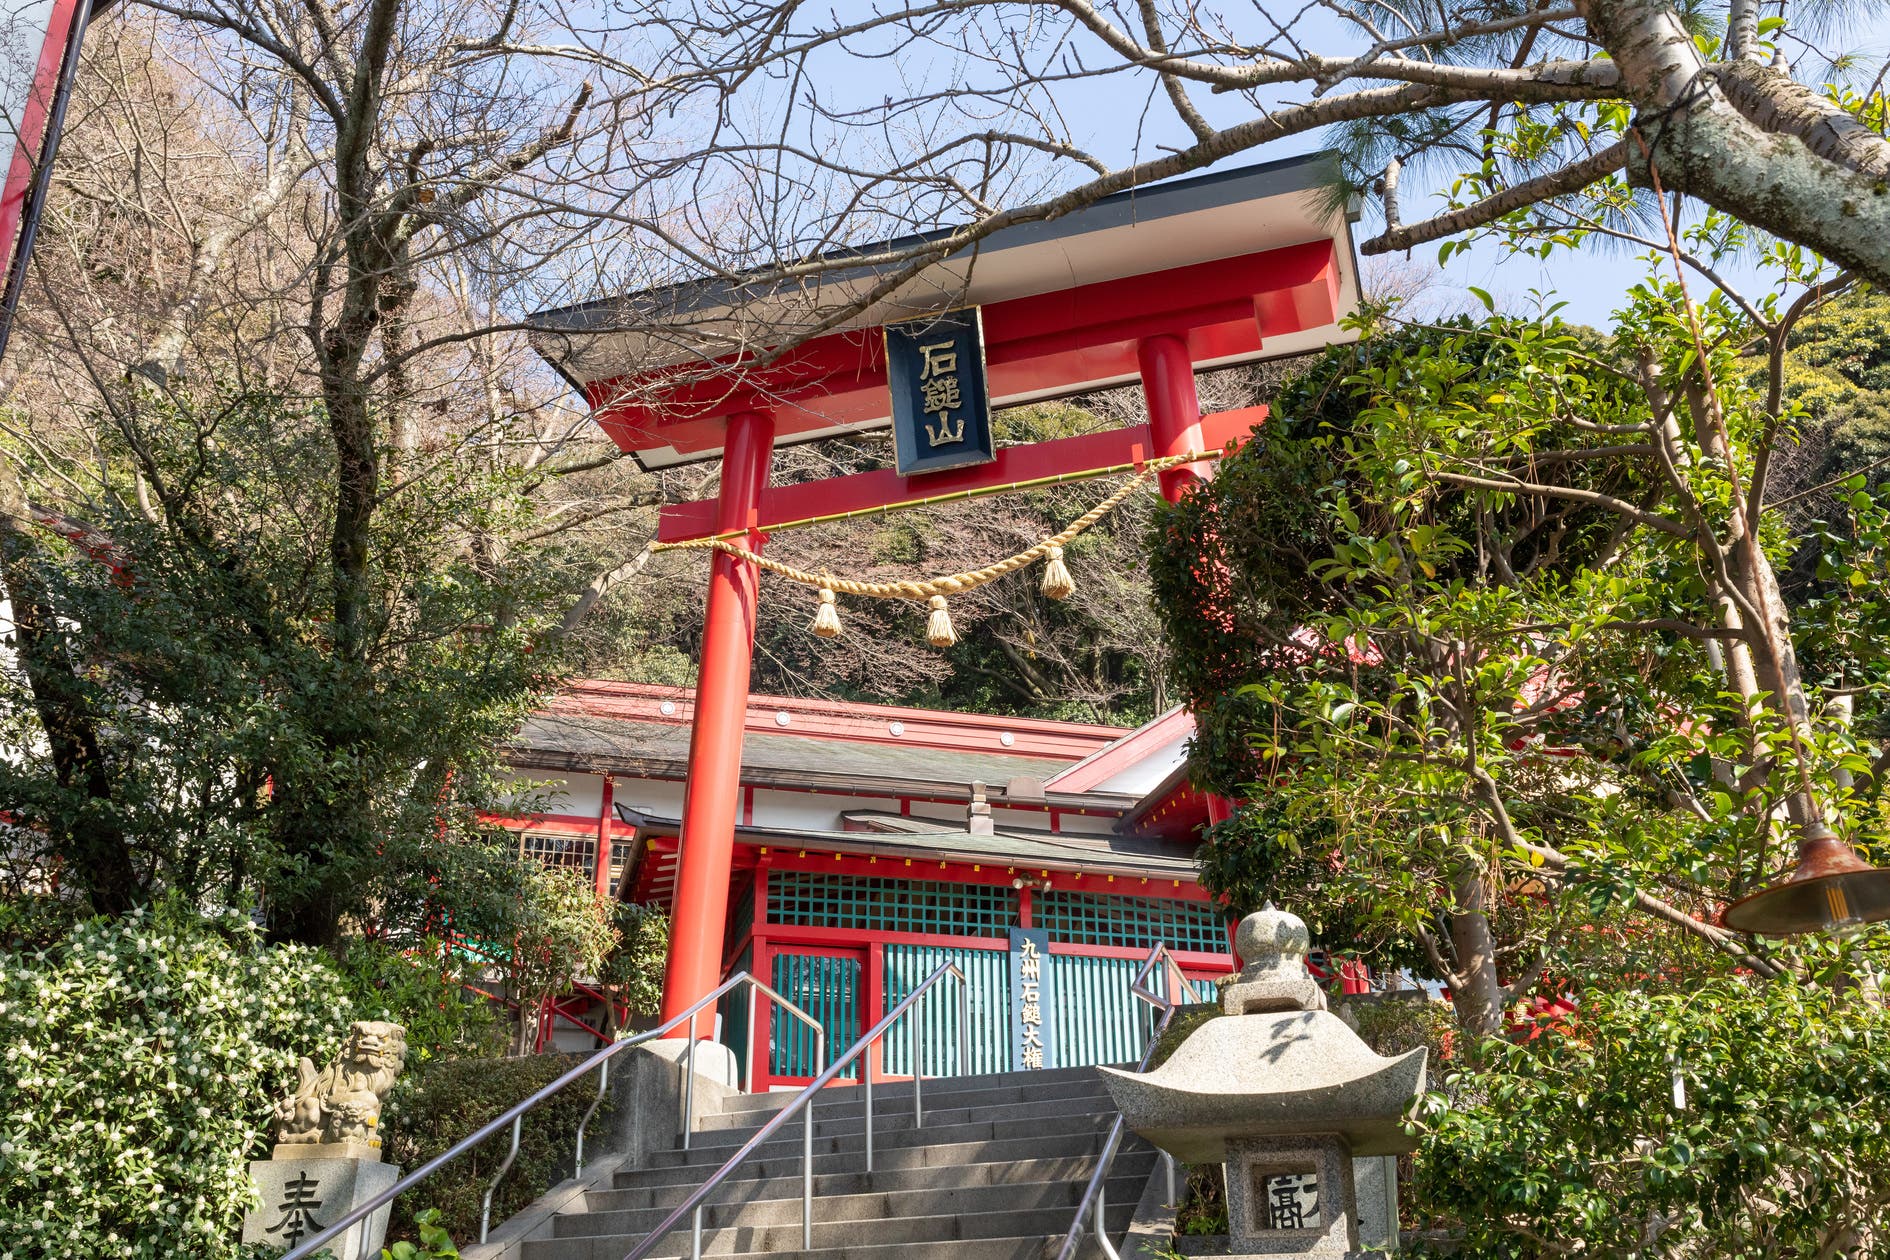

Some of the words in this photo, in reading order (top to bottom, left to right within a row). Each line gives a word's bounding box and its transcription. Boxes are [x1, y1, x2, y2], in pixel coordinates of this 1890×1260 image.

[919, 340, 965, 447] 石鎚山
[1020, 937, 1043, 1071] 九州石鎚大権
[265, 1170, 326, 1250] 奉
